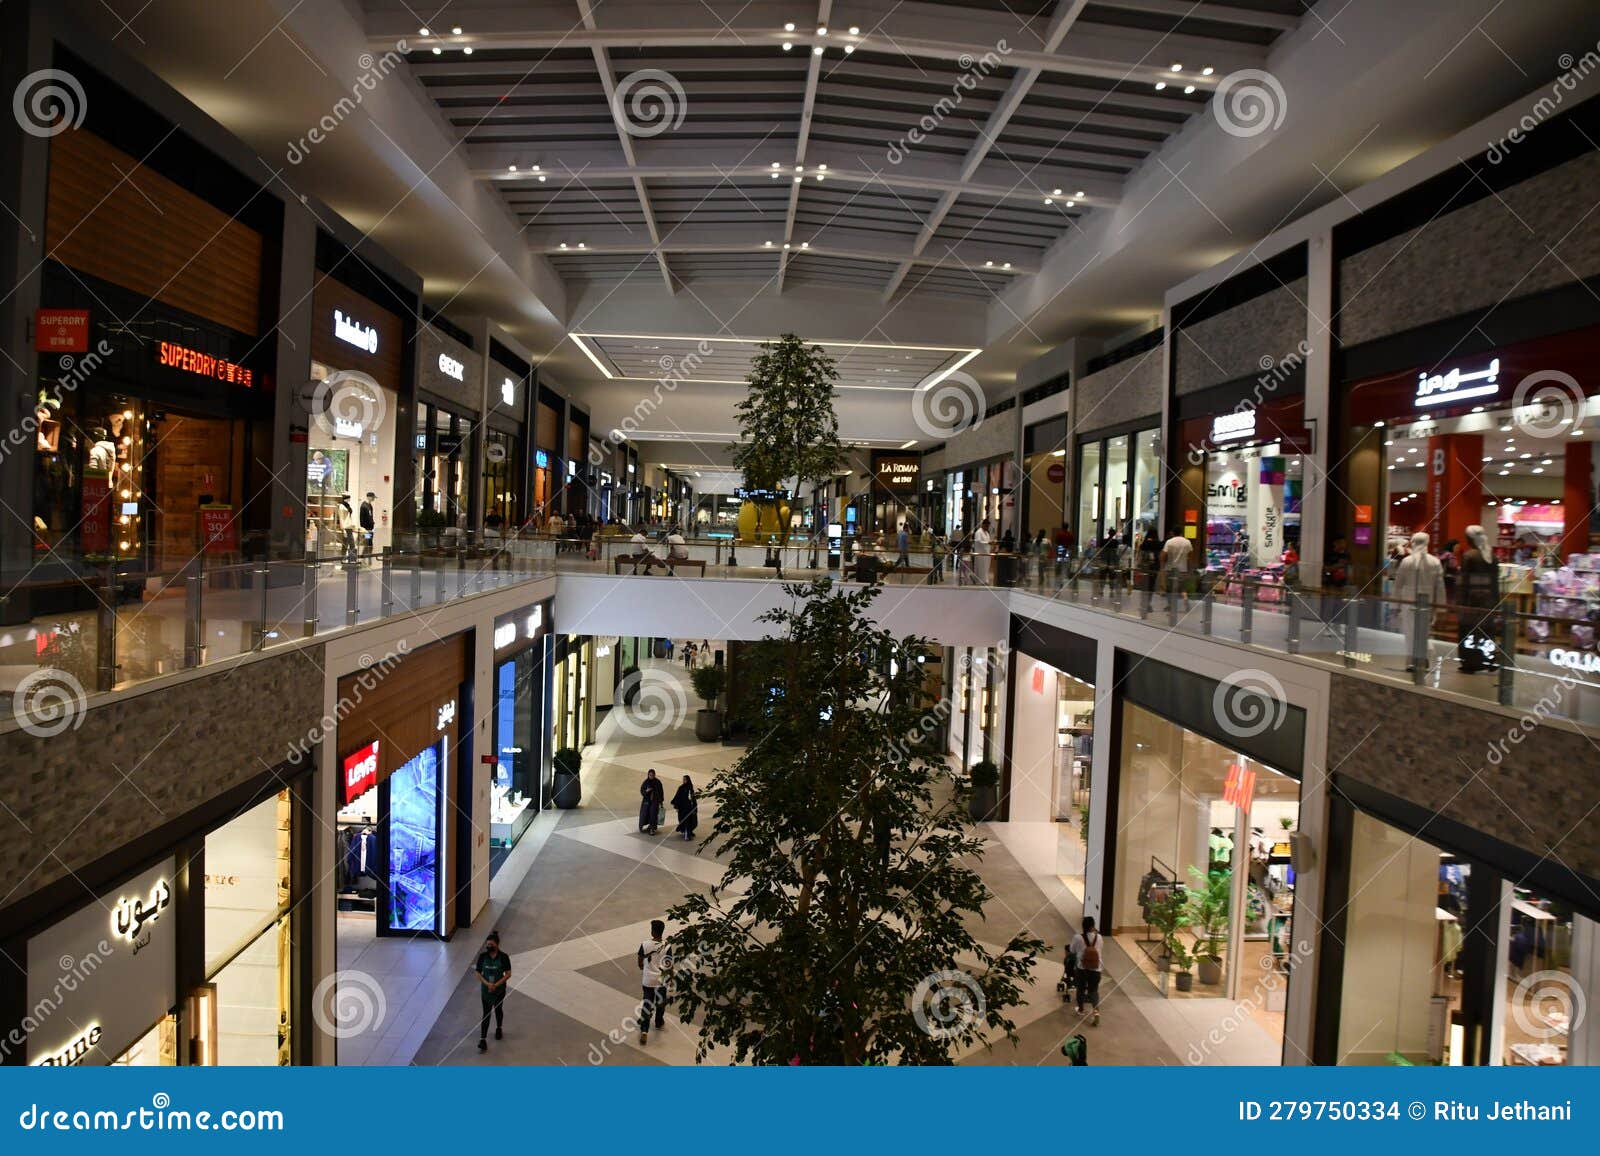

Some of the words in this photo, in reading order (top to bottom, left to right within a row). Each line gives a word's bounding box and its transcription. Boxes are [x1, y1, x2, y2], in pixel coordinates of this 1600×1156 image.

[40, 316, 86, 325] SUPERDRY
[160, 341, 216, 378] SUPERDRY
[82, 486, 106, 497] SALE
[204, 512, 229, 520] SALE
[208, 522, 223, 532] 30
[1262, 507, 1277, 548] smiggle
[40, 1026, 103, 1066] une
